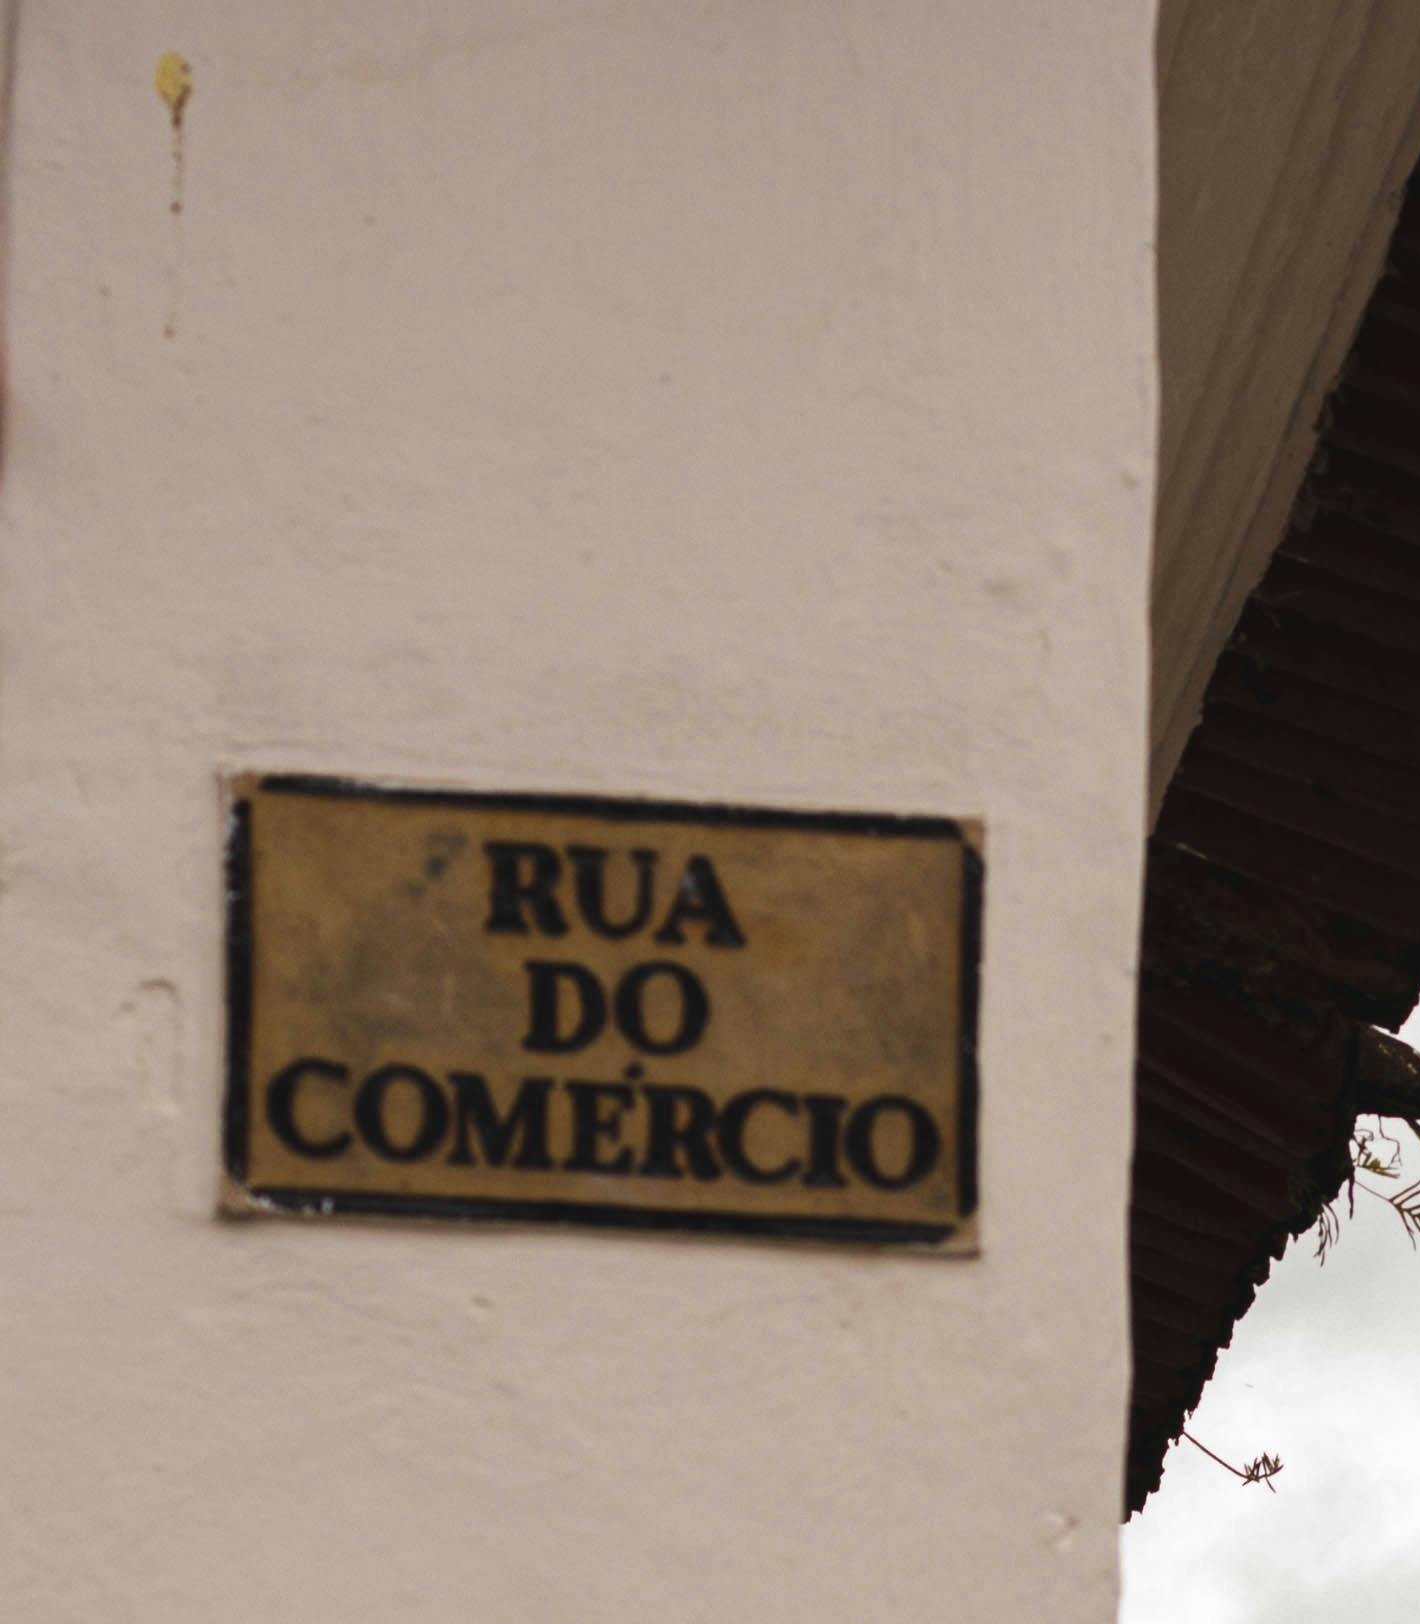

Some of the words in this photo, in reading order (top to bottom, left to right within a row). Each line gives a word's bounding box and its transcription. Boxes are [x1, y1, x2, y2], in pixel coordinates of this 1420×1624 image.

[481, 839, 748, 950] RUA
[520, 957, 712, 1058] DO
[263, 1055, 943, 1194] COMÉRCIO
